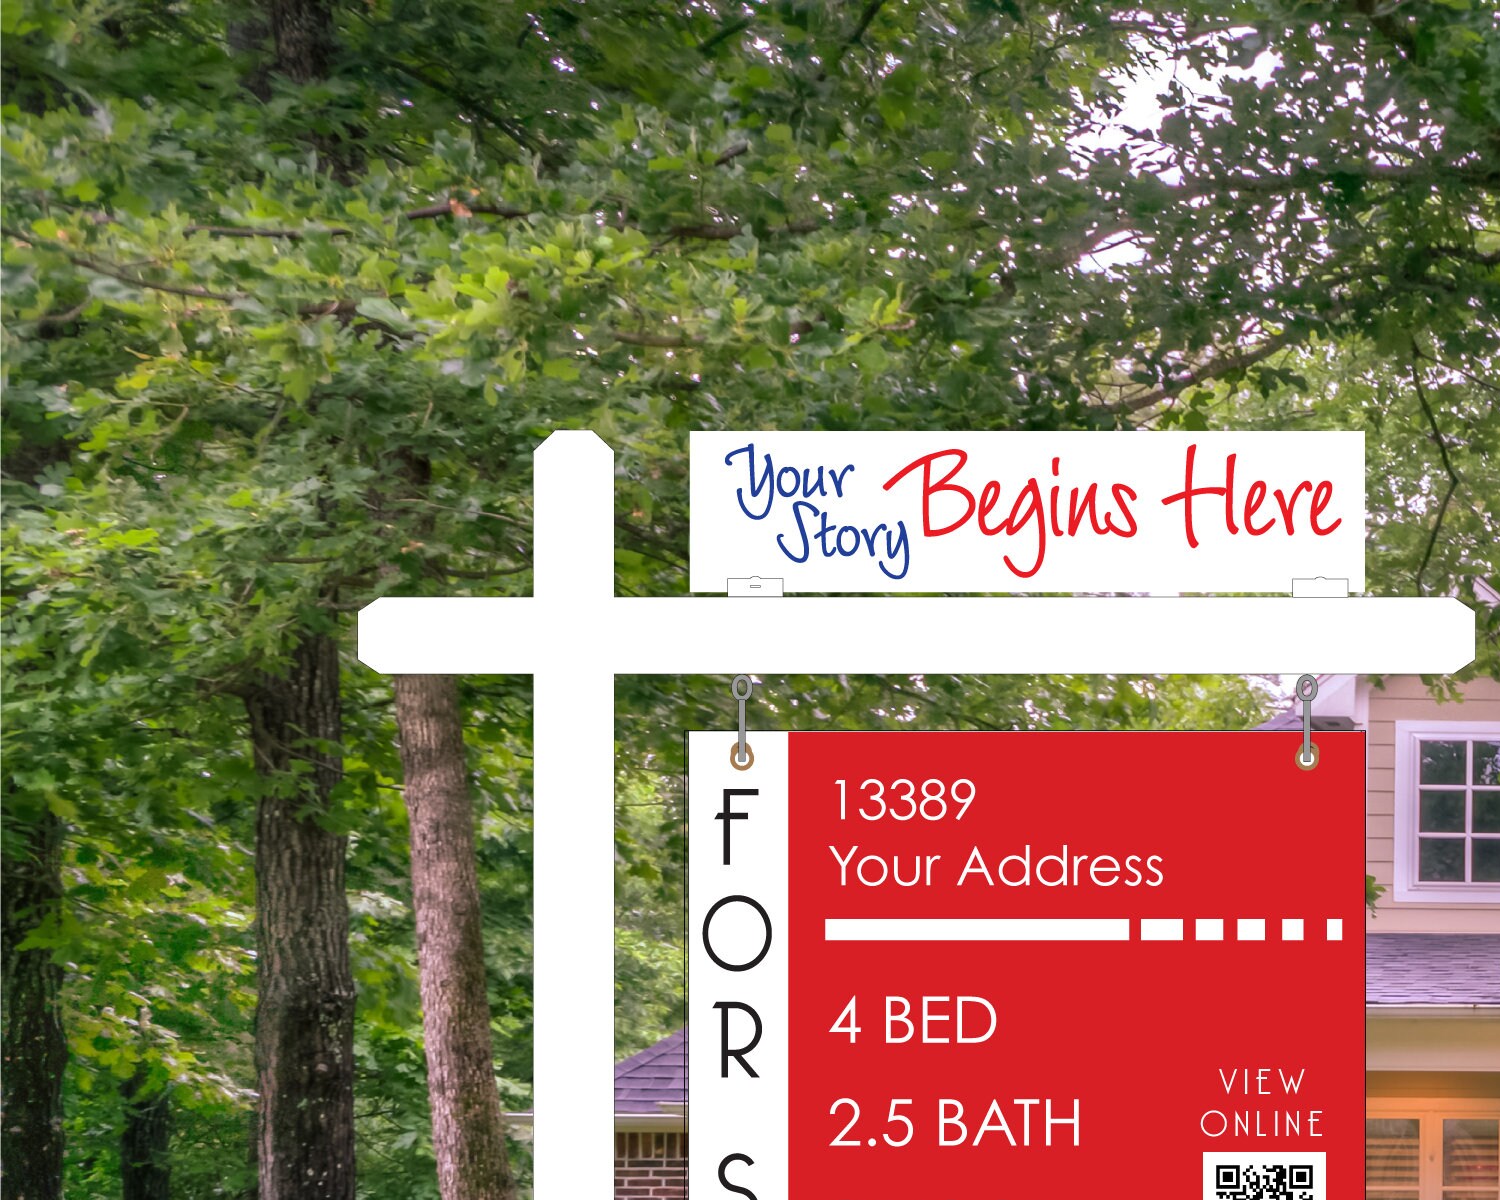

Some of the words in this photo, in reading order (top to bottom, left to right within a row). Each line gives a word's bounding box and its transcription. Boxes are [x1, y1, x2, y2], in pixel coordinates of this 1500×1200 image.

[724, 443, 856, 521] Your
[882, 448, 1138, 579] Begins
[1161, 443, 1343, 549] Here
[776, 500, 910, 580] Story
[834, 778, 976, 821] 13389
[828, 845, 942, 887] Your
[956, 844, 1164, 887] Address
[702, 788, 773, 1078] FOR
[828, 995, 862, 1044] 4
[885, 995, 997, 1044] BED
[1218, 1068, 1305, 1095] VIEW
[829, 1097, 914, 1148] 2.5
[938, 1098, 1080, 1147] BATH
[1200, 1109, 1323, 1138] ONLINE
